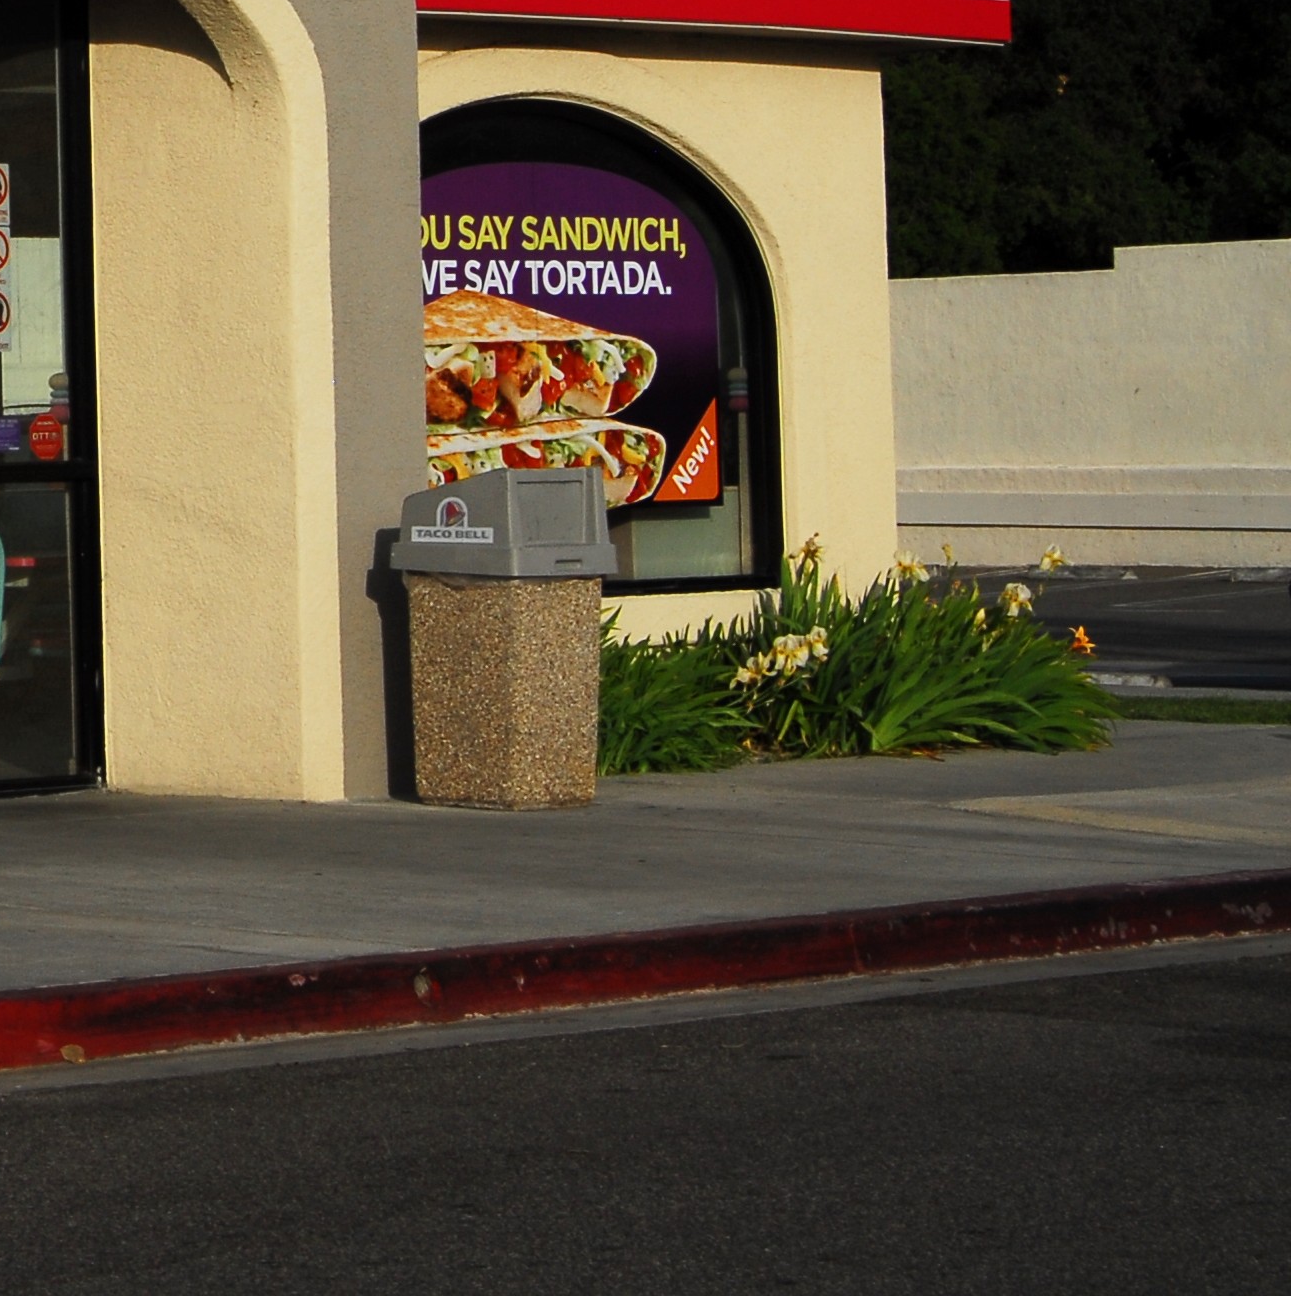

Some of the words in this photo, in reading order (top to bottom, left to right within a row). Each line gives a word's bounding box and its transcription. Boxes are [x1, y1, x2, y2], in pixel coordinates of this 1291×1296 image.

[457, 214, 515, 251] SAY
[521, 215, 687, 259] SANDWICH,
[464, 259, 521, 295] SAY
[524, 260, 673, 296] TORTADA.
[672, 425, 715, 494] New!
[415, 529, 452, 539] TACO
[455, 530, 489, 539] BELL
